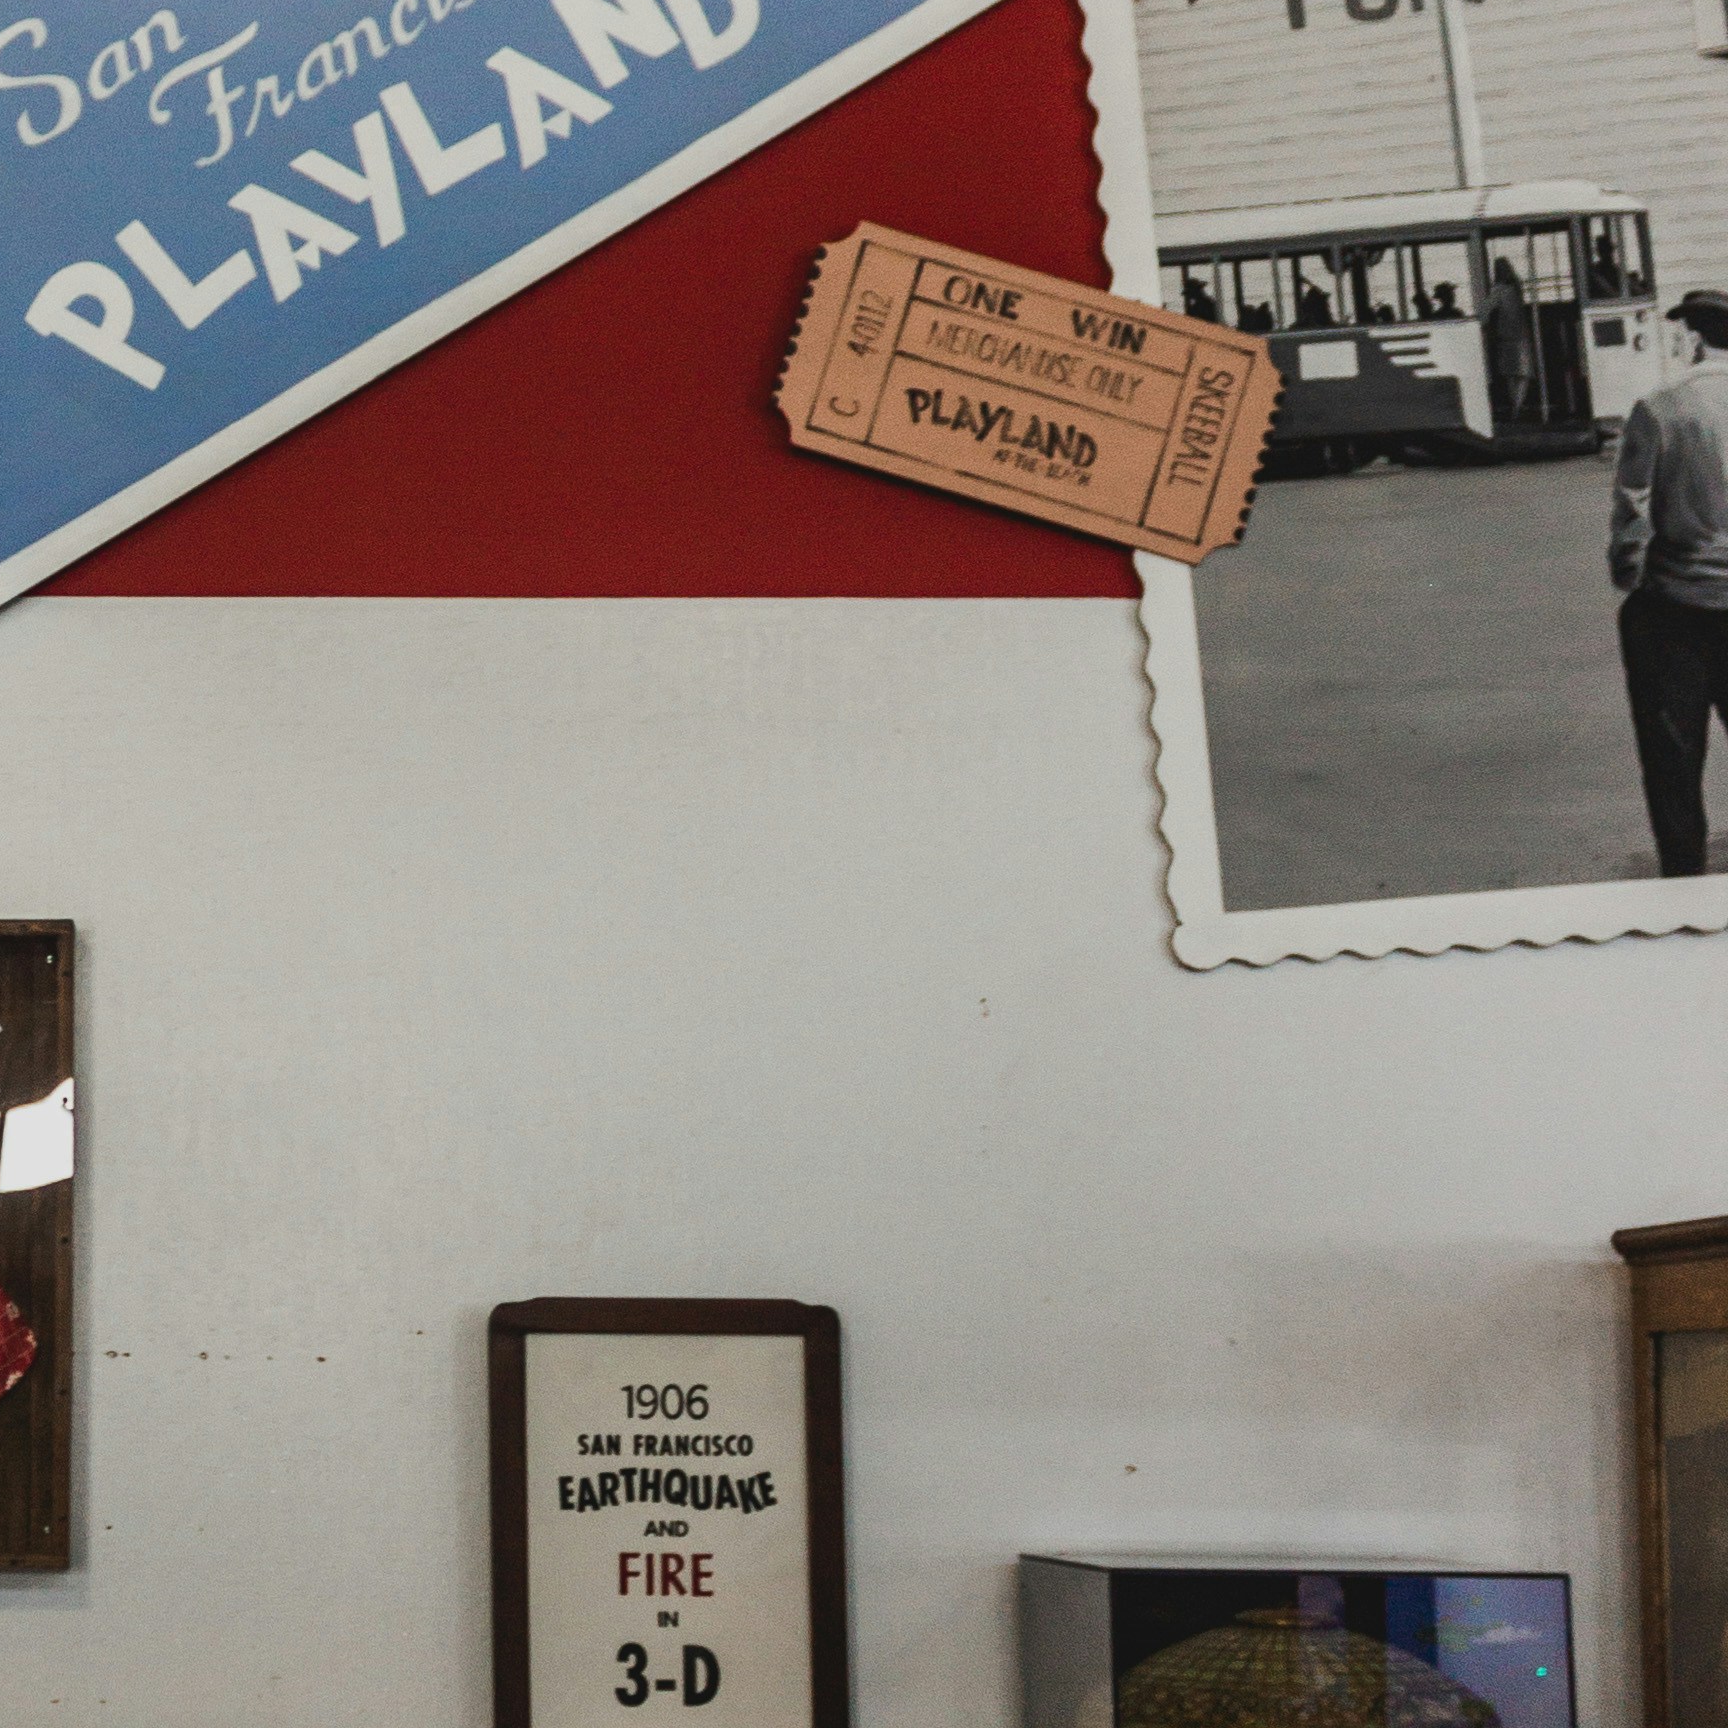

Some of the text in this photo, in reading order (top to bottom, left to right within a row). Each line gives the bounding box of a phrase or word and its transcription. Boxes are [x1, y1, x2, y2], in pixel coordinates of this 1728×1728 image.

[943, 274, 1148, 355] ONE WIN
[828, 394, 861, 418] C
[904, 386, 1099, 469] PLAYLAND
[1168, 365, 1234, 487] SKEEBALL
[620, 1383, 711, 1421] 1906
[577, 1433, 755, 1458] SAN FRANCISCO
[558, 1467, 779, 1515] EARTHQUAKE
[643, 1520, 690, 1539] AND
[618, 1551, 715, 1598] FIRE
[656, 1610, 680, 1629] IN
[614, 1641, 722, 1707] 3-D
